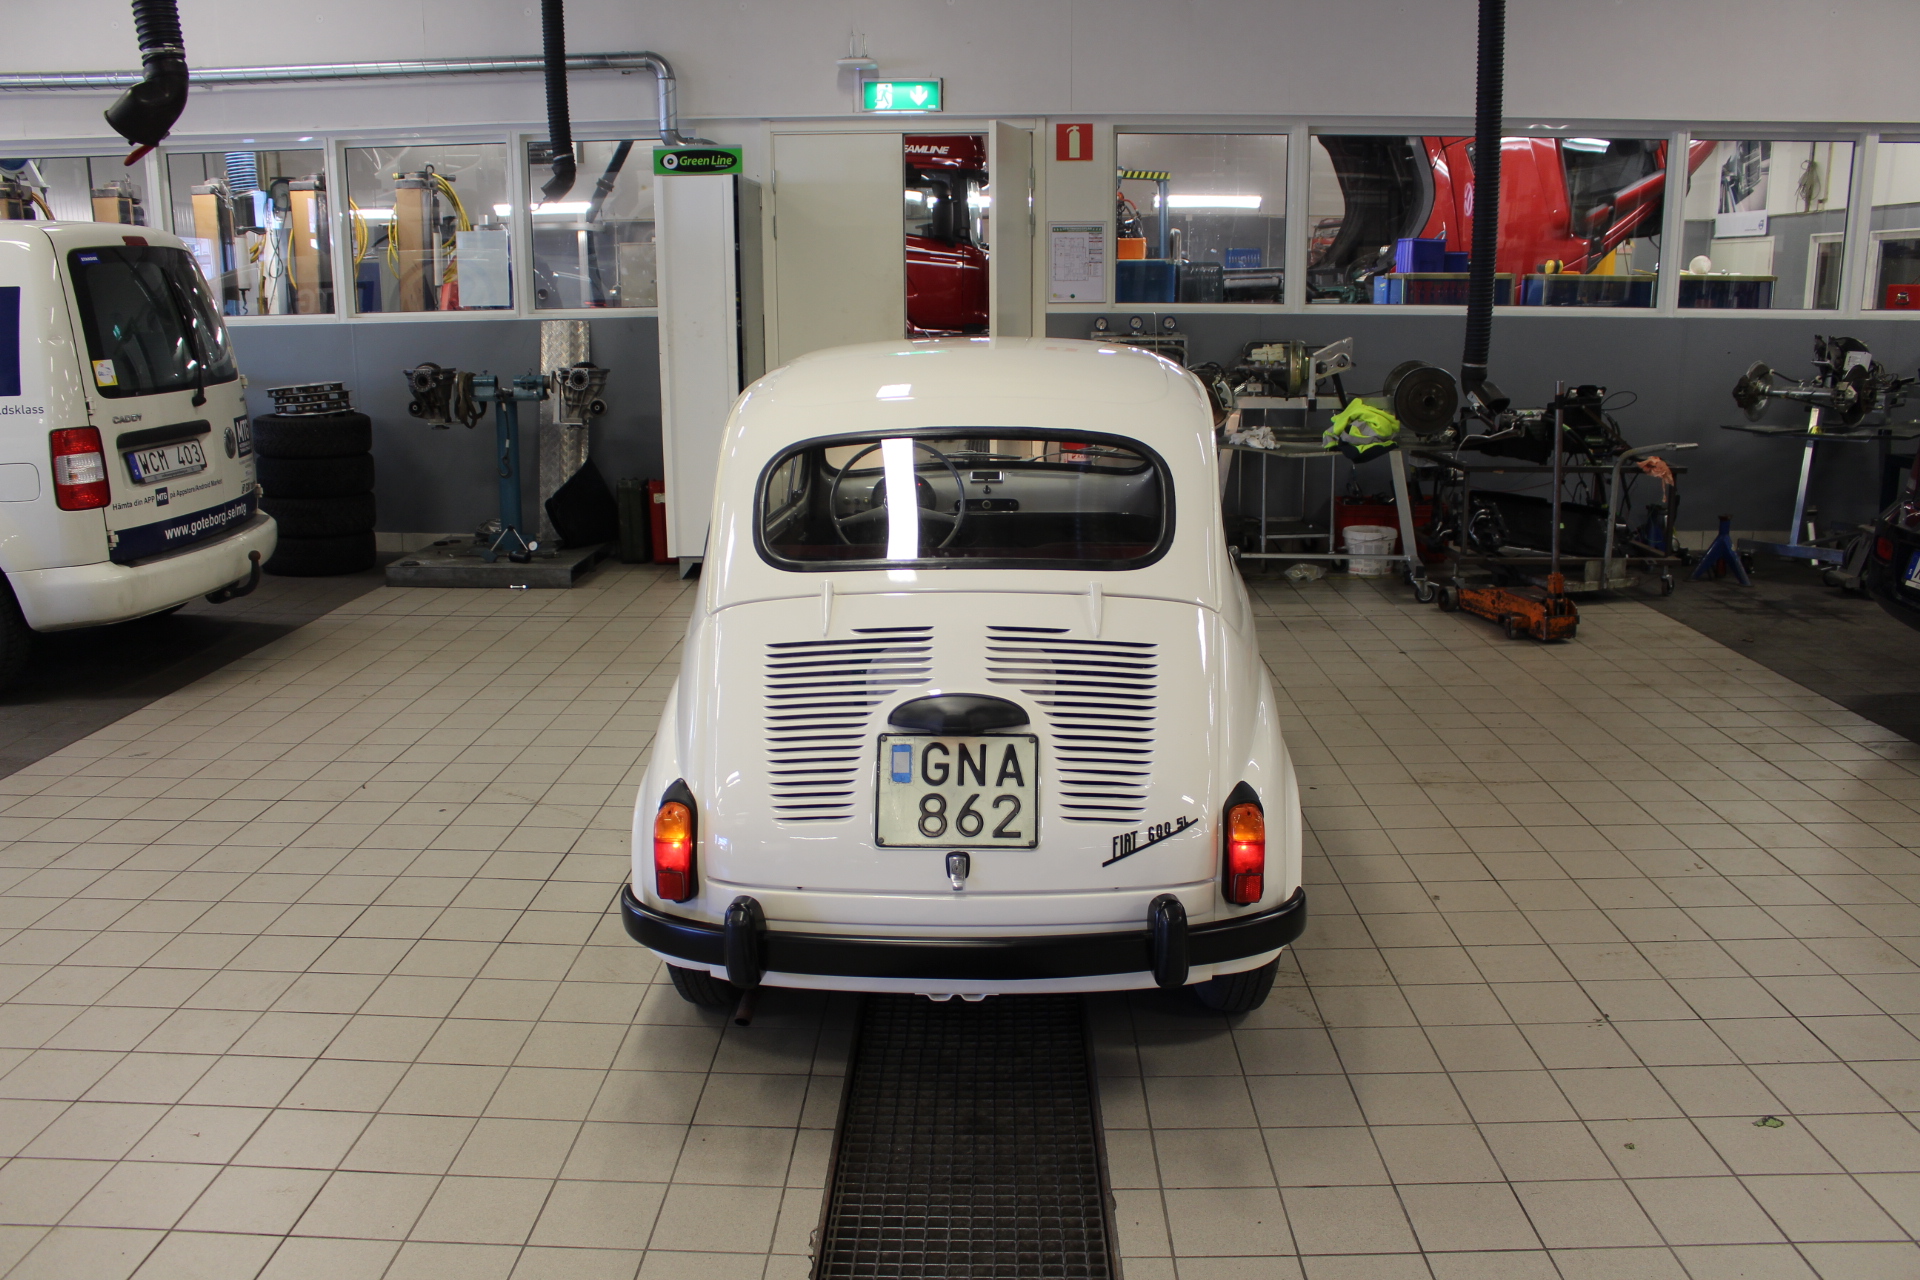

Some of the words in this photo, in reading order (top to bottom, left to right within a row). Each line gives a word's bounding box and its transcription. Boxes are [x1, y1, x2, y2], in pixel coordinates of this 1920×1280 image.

[680, 156, 709, 166] Green
[711, 154, 733, 165] Line
[0, 404, 44, 415] dsklass
[112, 414, 142, 424] CADDY
[138, 449, 170, 475] WCM
[176, 444, 201, 466] 403
[112, 500, 133, 511] Hämta
[134, 498, 144, 507] din
[144, 495, 156, 504] APP
[165, 503, 246, 540] www.goteborg.se/mtg
[921, 741, 1025, 787] GNA
[918, 793, 1021, 838] 862
[1113, 830, 1138, 859] FIAT
[1148, 821, 1171, 842] 600
